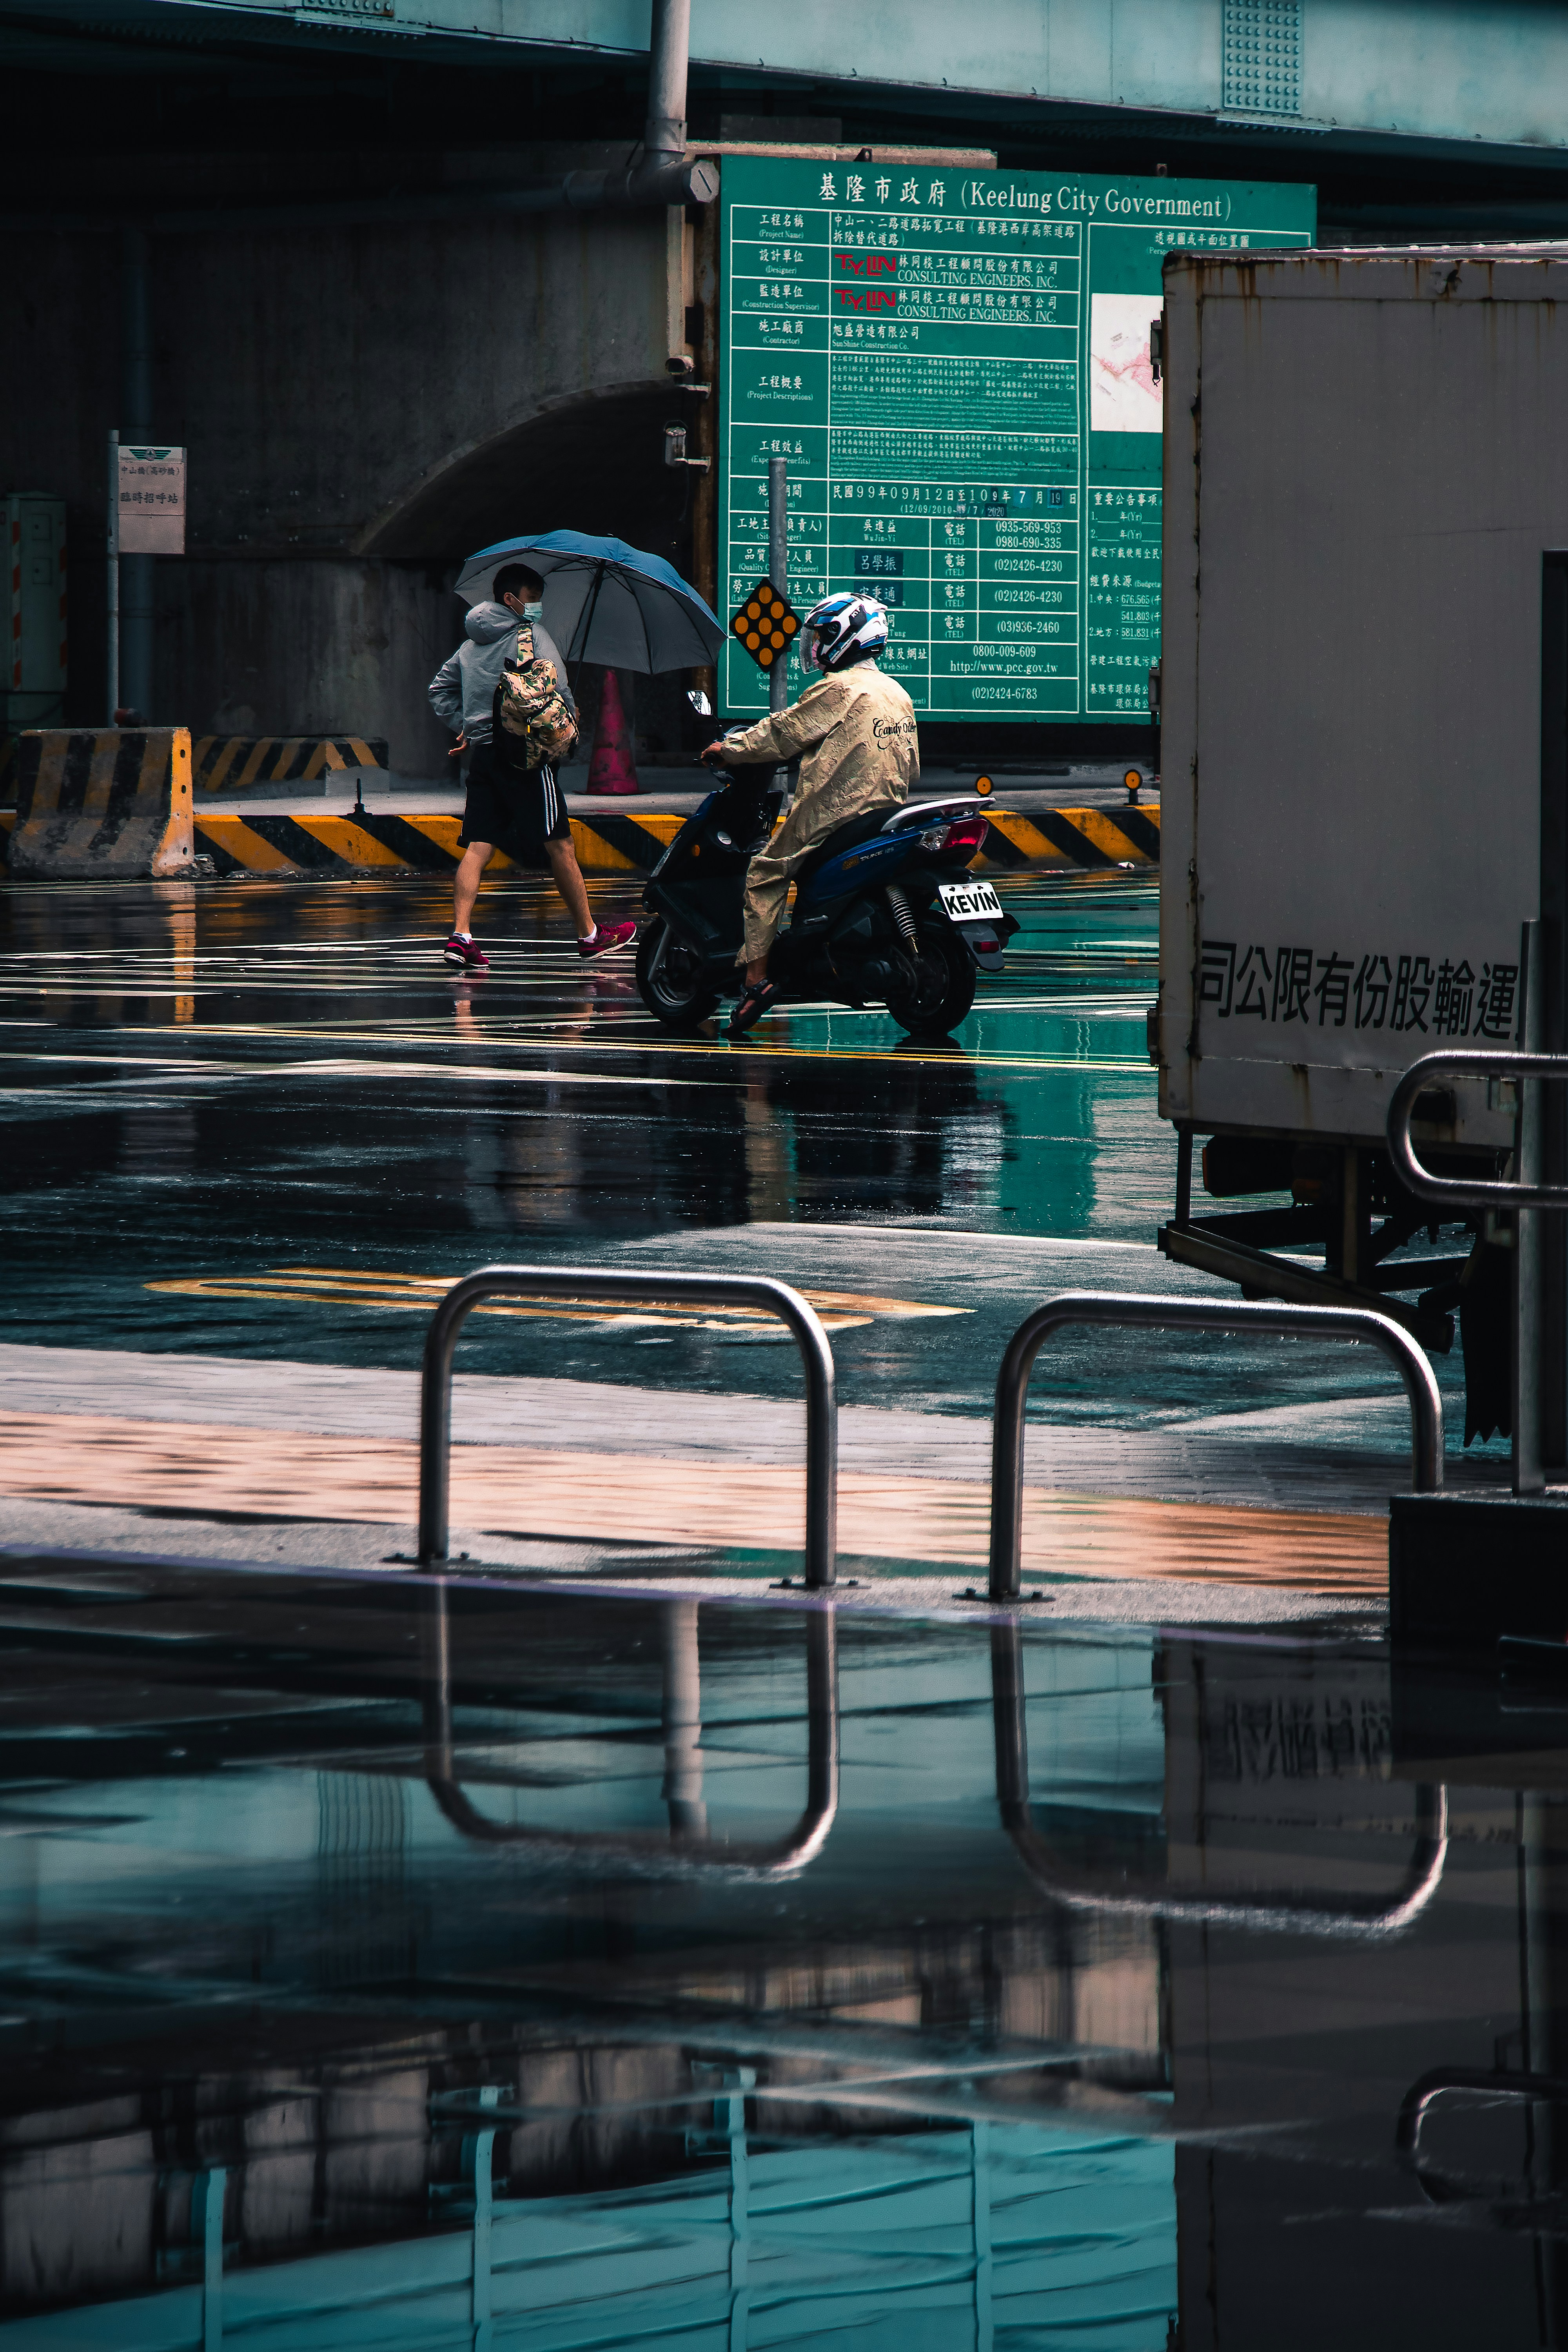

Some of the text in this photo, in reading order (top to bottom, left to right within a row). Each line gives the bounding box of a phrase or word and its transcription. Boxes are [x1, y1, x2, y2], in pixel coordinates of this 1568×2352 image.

[819, 172, 1230, 223] 基隆市政府 (Keelung City Government)
[760, 214, 804, 228] 工程名稱
[759, 249, 804, 263] 設計單位
[898, 267, 967, 285] CONSULTING
[1036, 276, 1057, 288] INC.
[760, 284, 803, 298] 監造單位
[897, 304, 967, 321] CONSULTING
[1036, 311, 1056, 323] INC.
[759, 319, 803, 334] 施工廠商
[833, 321, 920, 339] 旭盛營造有限公司
[759, 376, 802, 389] 工程概要
[748, 391, 771, 400] (Project
[760, 440, 803, 453] 工程效益
[120, 492, 178, 504] 臨時招呼站
[864, 519, 896, 533] 吳進益
[944, 522, 965, 536] 電話
[996, 521, 1062, 534] 0935-569-953
[996, 536, 1062, 549] 0980-690-335
[862, 555, 896, 570] 呂學振
[945, 553, 965, 567] 電話
[995, 559, 1062, 572] (02)2426-4230
[739, 564, 763, 572] (Quality
[790, 564, 818, 573] Engineer)
[1090, 574, 1132, 587] 經費來源
[945, 584, 965, 598] 電話
[995, 590, 1062, 603] (02)2426-4230
[945, 615, 965, 629] 電話
[997, 621, 1059, 633] (03)936-2460
[973, 644, 1037, 657] 0800-009-609
[950, 660, 1059, 675] http://www.pcc.gov.tw
[972, 687, 1037, 699] (02)2424-6783
[944, 891, 1000, 915] KEVIN
